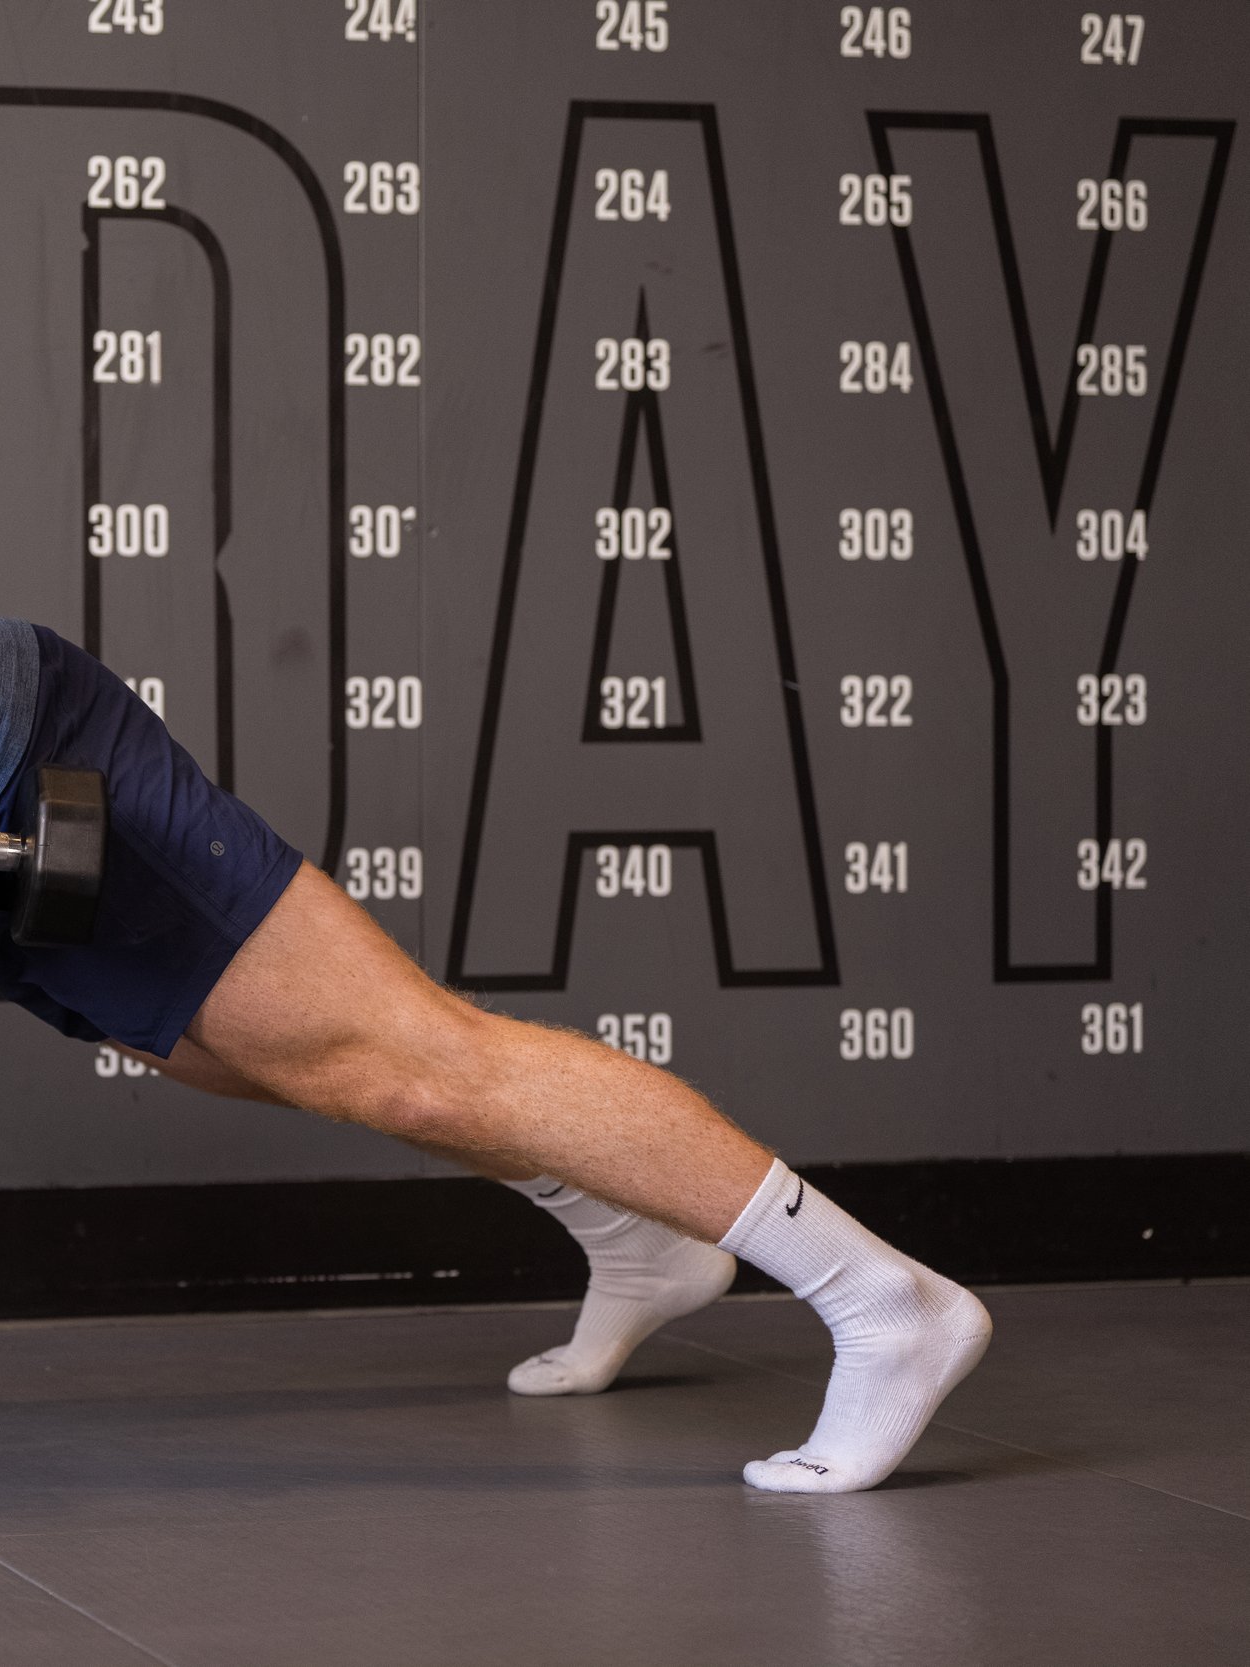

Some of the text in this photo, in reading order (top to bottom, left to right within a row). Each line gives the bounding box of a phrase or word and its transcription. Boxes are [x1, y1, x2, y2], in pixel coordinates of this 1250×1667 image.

[87, 0, 164, 35] 243
[344, 0, 416, 43] 244
[596, 0, 668, 52] 245
[840, 6, 911, 58] 246
[1081, 14, 1144, 64] 247
[87, 154, 166, 209] 262
[343, 160, 420, 215] 263
[595, 168, 671, 222] 264
[839, 173, 912, 226] 265
[1077, 179, 1147, 230] 266
[93, 329, 162, 385] 281
[345, 333, 421, 387] 282
[595, 338, 670, 391] 283
[840, 341, 913, 393] 284
[1078, 345, 1147, 395] 285
[89, 503, 169, 558] 300
[349, 504, 417, 558] 30
[595, 507, 671, 560] 302
[839, 508, 913, 560] 303
[1076, 510, 1148, 560] 304
[346, 676, 422, 729] 320
[601, 676, 666, 728] 321
[840, 675, 913, 727] 322
[1077, 674, 1147, 725] 323
[346, 846, 423, 900] 339
[596, 846, 671, 898] 340
[845, 842, 907, 894] 341
[1078, 839, 1146, 889] 342
[596, 1012, 672, 1065] 359
[840, 1009, 914, 1060] 360
[1082, 1004, 1142, 1054] 361
